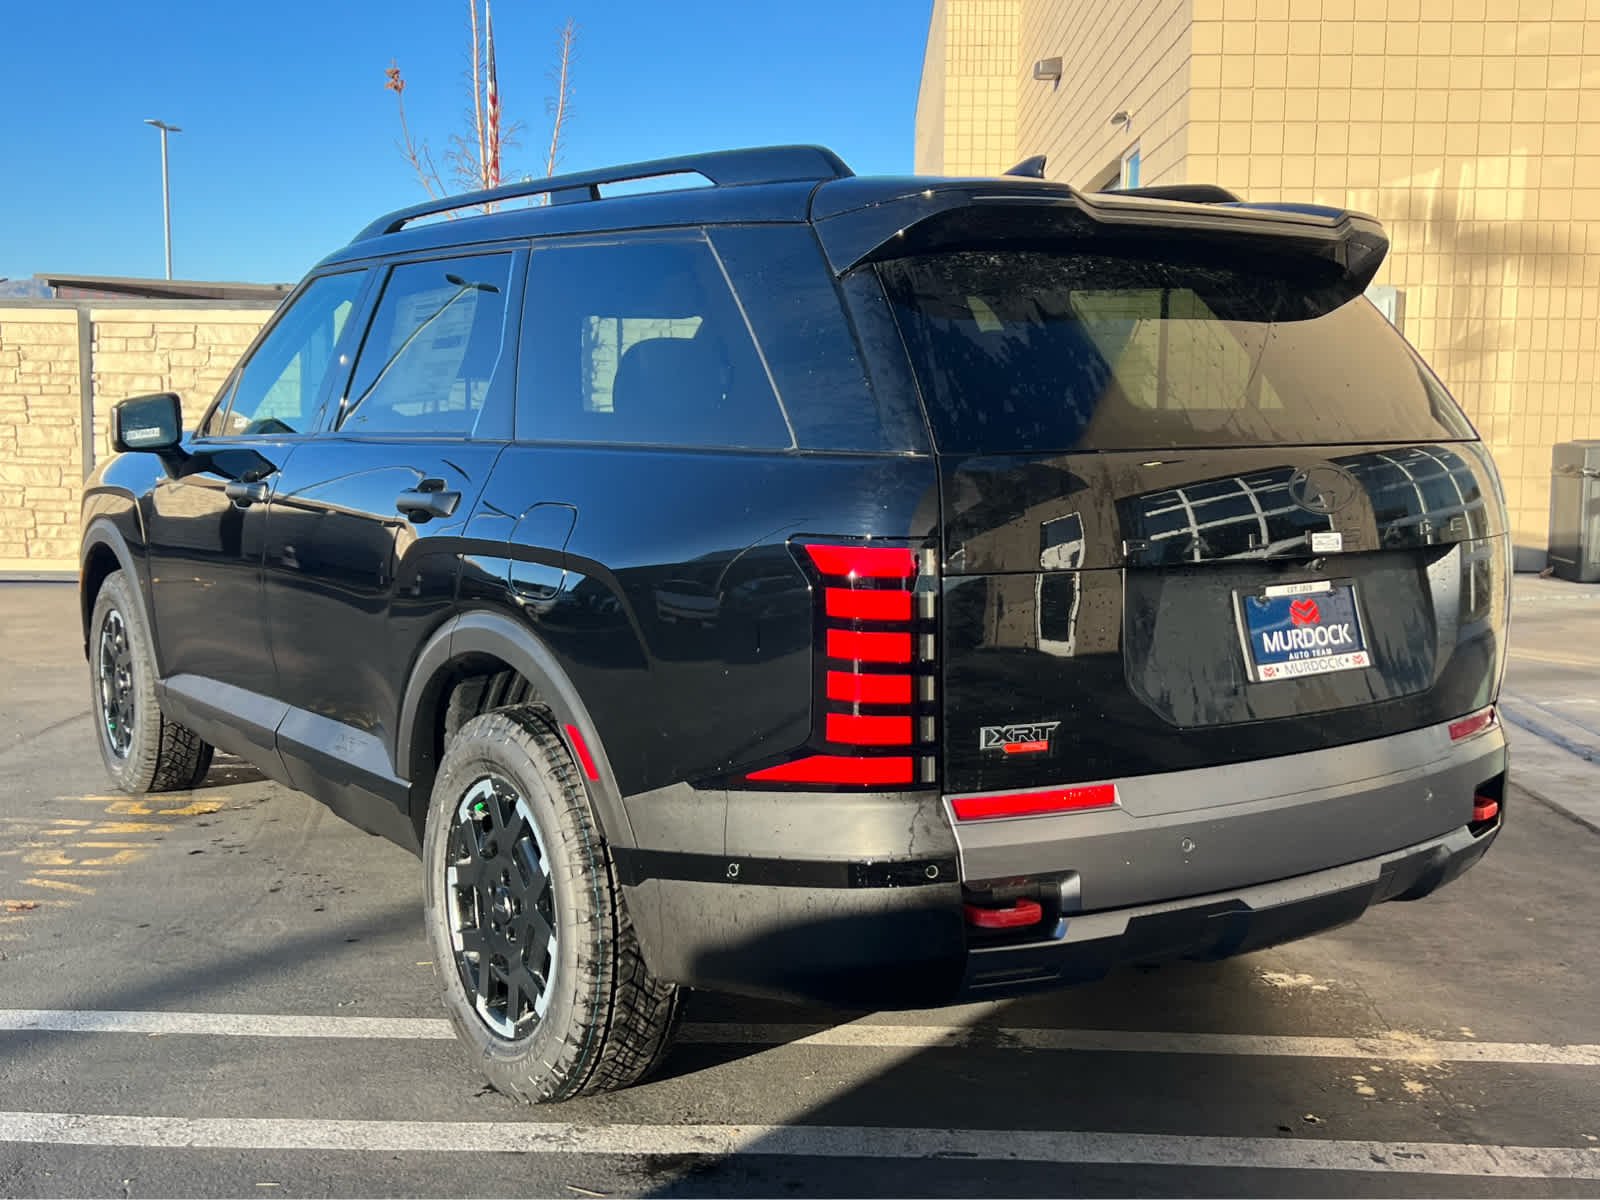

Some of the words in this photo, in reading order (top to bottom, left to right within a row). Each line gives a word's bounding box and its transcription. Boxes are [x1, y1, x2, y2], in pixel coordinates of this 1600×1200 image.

[1263, 624, 1352, 653] MURDOCK
[1284, 656, 1344, 675] MURDOCK
[1289, 651, 1310, 660] AUTO
[1312, 648, 1332, 657] TEAM
[980, 721, 1061, 750] XRT
